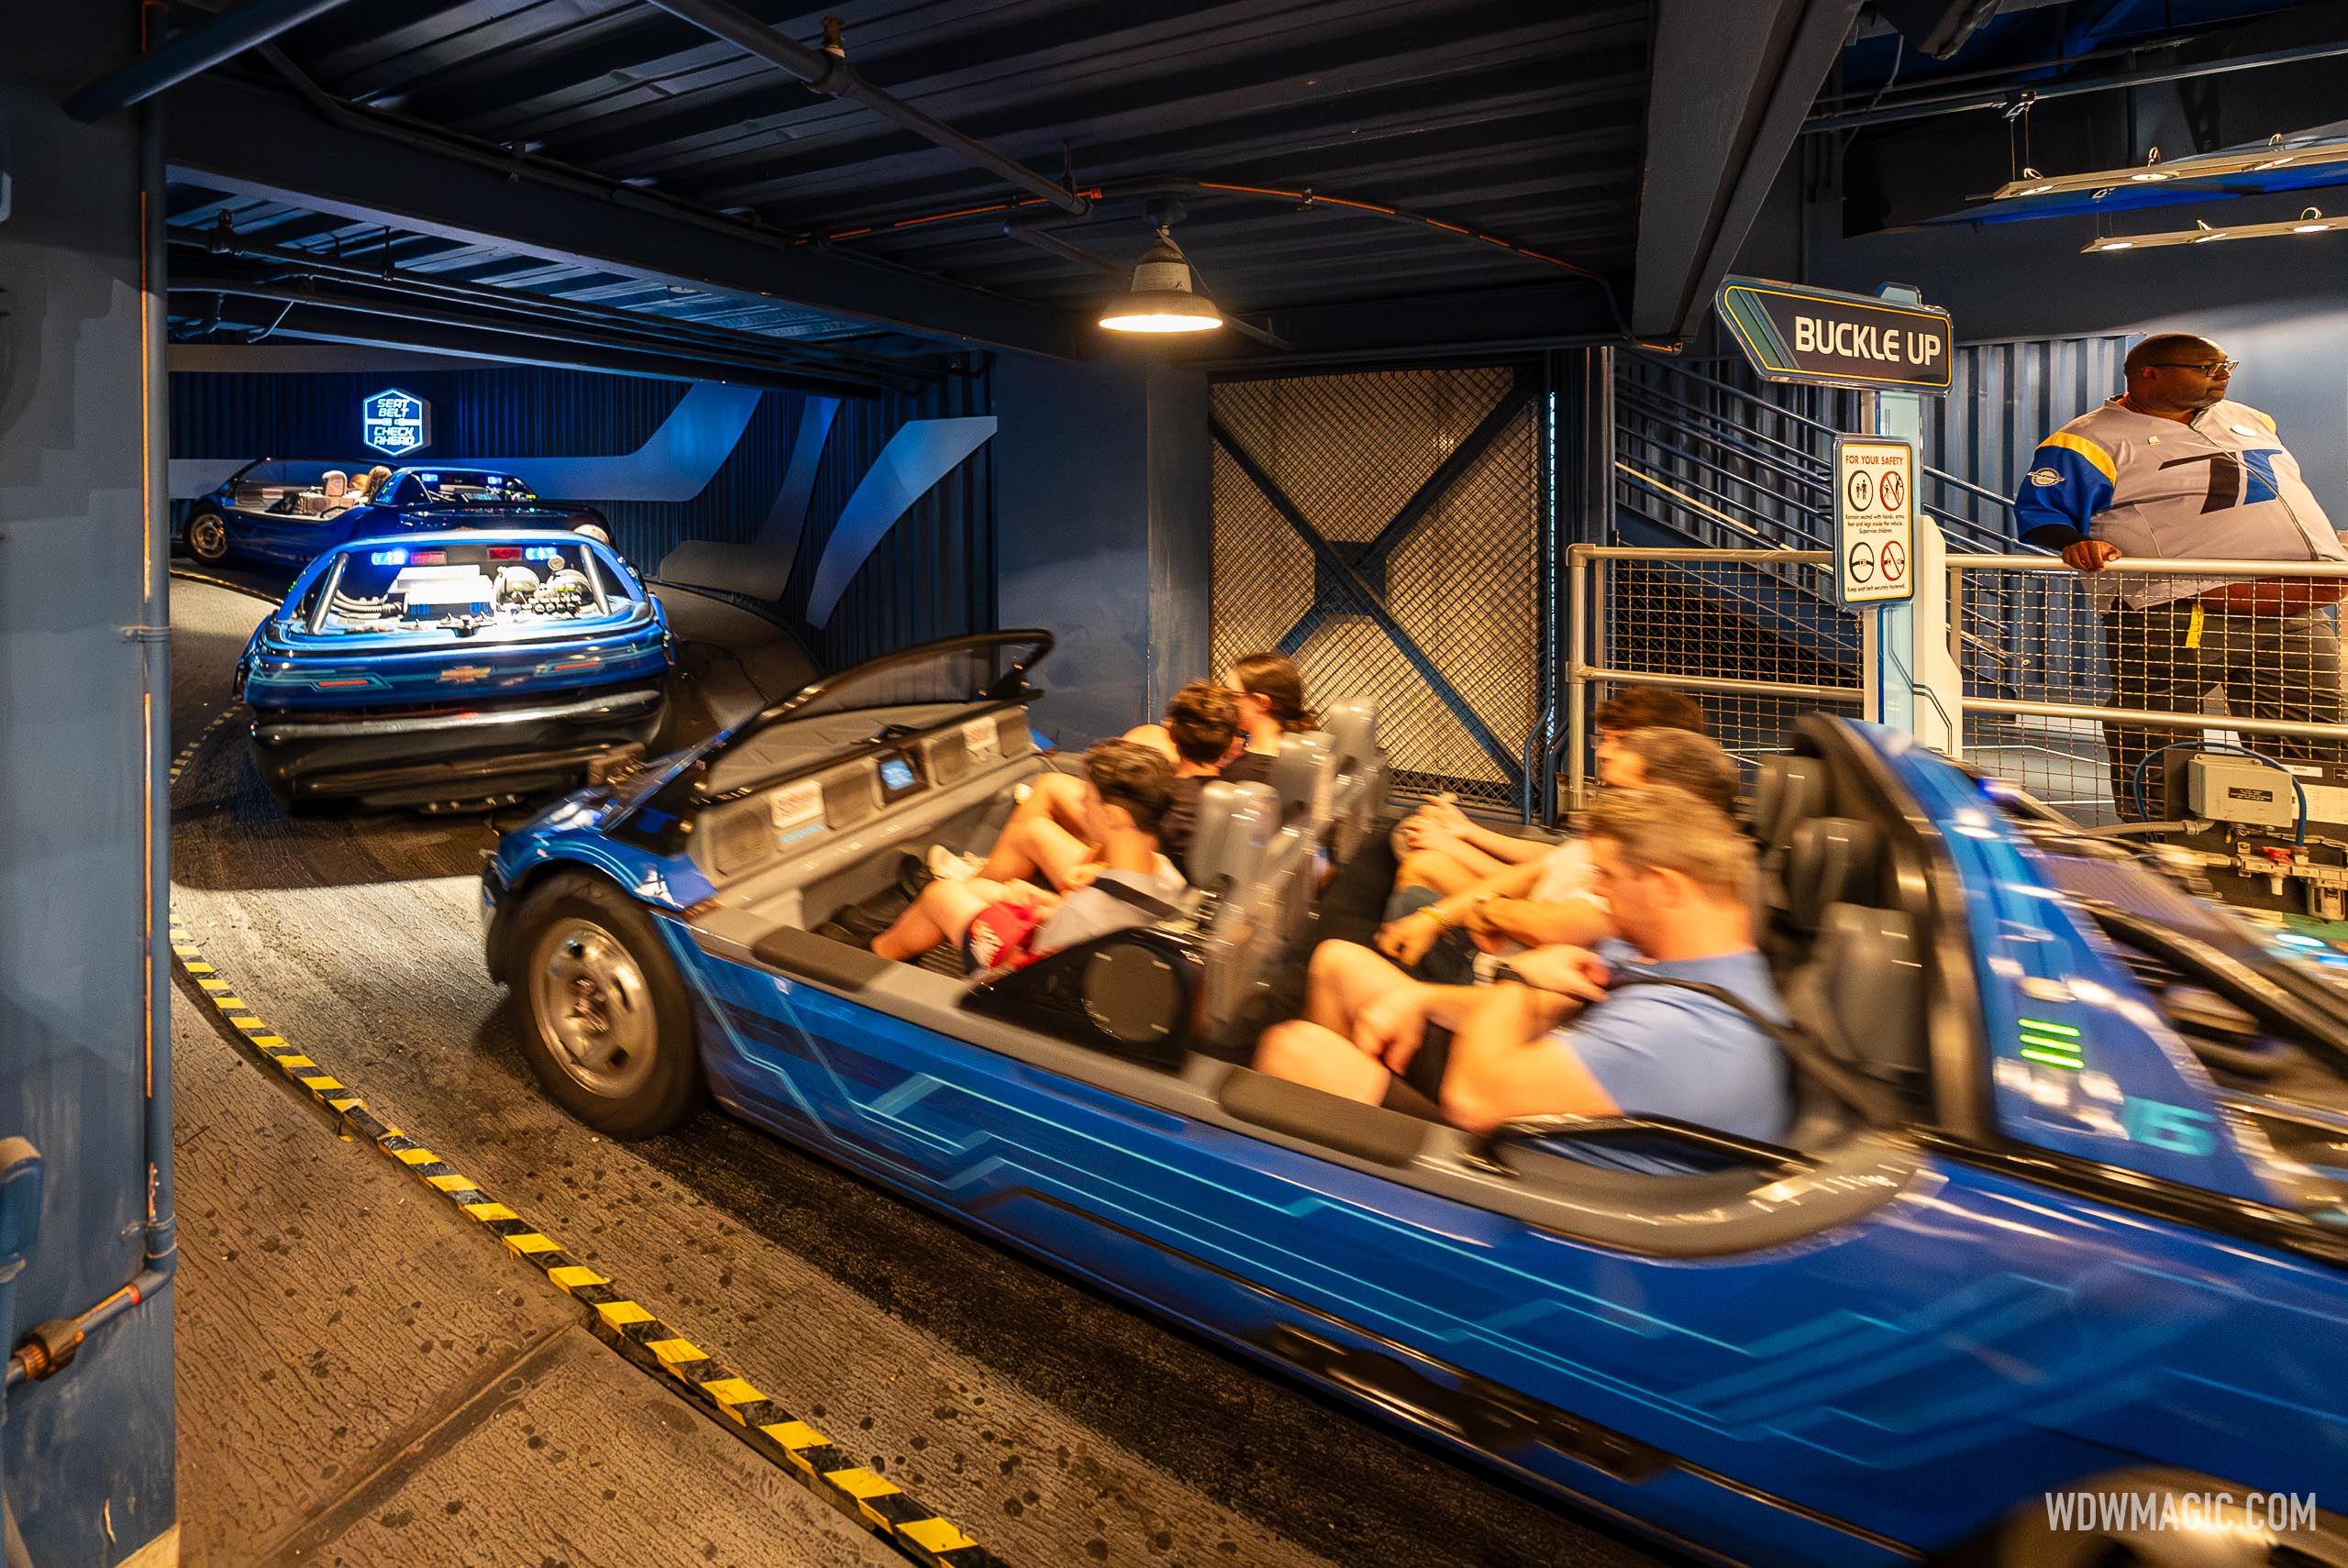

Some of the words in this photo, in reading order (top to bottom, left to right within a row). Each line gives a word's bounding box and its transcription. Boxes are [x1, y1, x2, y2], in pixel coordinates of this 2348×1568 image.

[1795, 315, 1899, 362] BUCKLE
[1907, 331, 1942, 366] UP
[377, 398, 410, 408] SEAT
[378, 408, 409, 417] BELT
[373, 426, 415, 436] CHECK
[373, 436, 415, 446] AHEAD
[1845, 455, 1859, 465] FOR
[1861, 455, 1879, 465] YOUR
[1881, 456, 1903, 466] SAFETY
